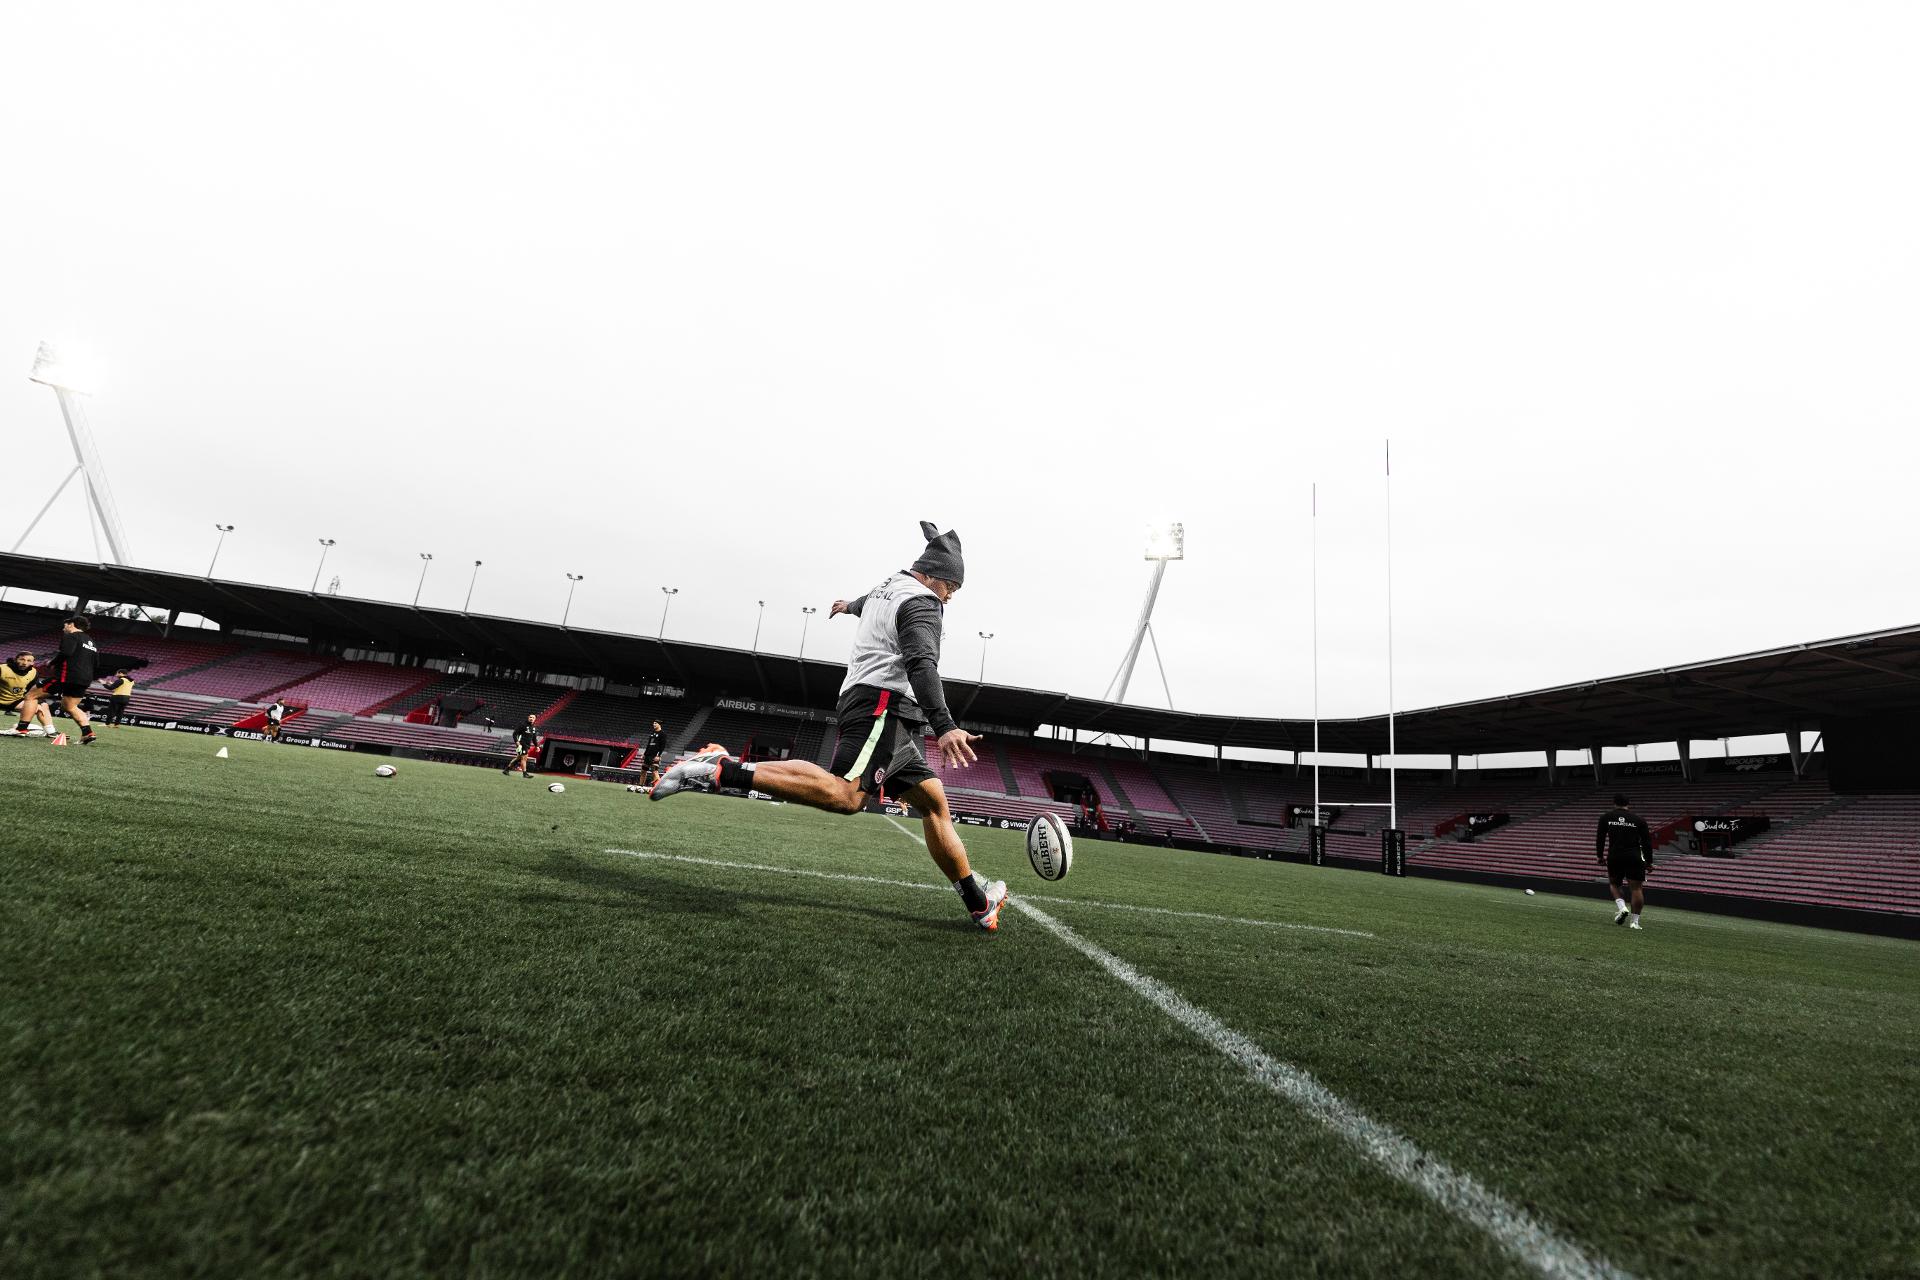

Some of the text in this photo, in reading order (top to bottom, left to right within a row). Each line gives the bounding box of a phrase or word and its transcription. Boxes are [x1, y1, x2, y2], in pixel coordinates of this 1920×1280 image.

[717, 699, 756, 711] AIRBUS
[177, 724, 203, 732] TOULOUSE
[286, 736, 310, 745] Groupe
[321, 740, 347, 749] Cailleau
[1635, 765, 1681, 775] FIDUCIAL
[1038, 824, 1054, 877] GILBERT
